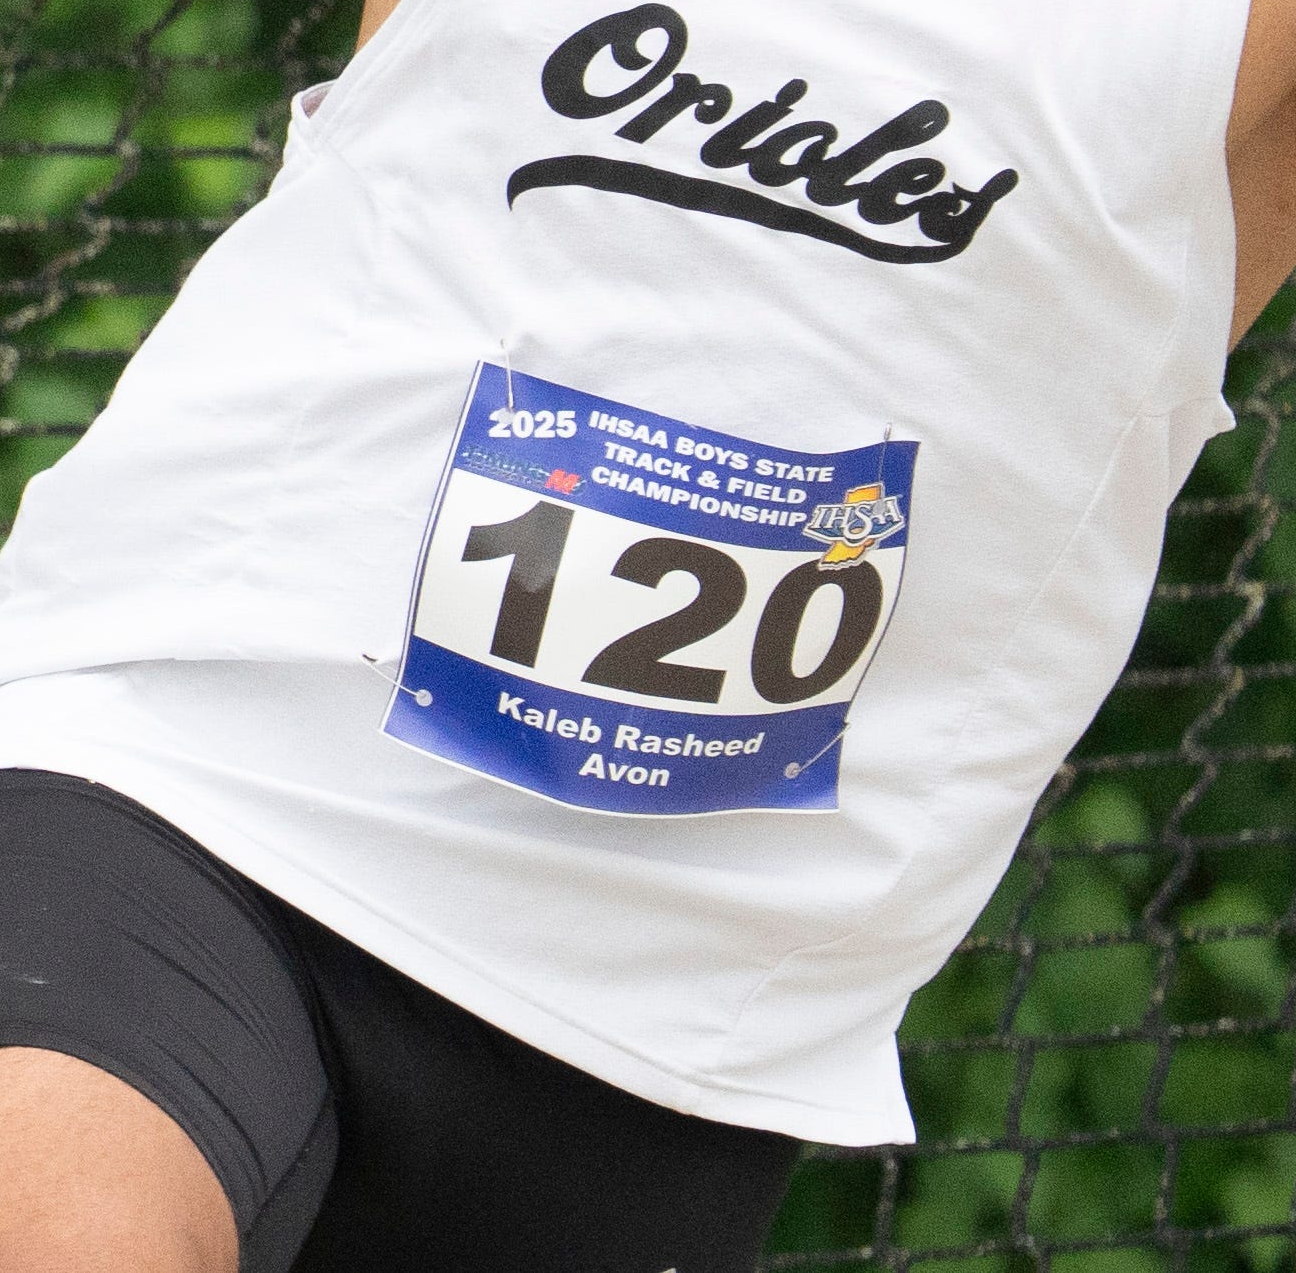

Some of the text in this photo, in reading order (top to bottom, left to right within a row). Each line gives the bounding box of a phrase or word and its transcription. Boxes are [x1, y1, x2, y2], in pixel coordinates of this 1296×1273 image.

[541, 3, 1019, 245] Orioles
[487, 407, 578, 439] 2025
[588, 410, 836, 483] IHSAA BOYS STATE
[591, 465, 808, 528] CHAMPIONSHIP
[604, 441, 808, 505] TRACK & FIELD
[460, 501, 884, 705] 120
[497, 691, 766, 758] Kaleb Rasheed
[578, 753, 671, 787] Avon
